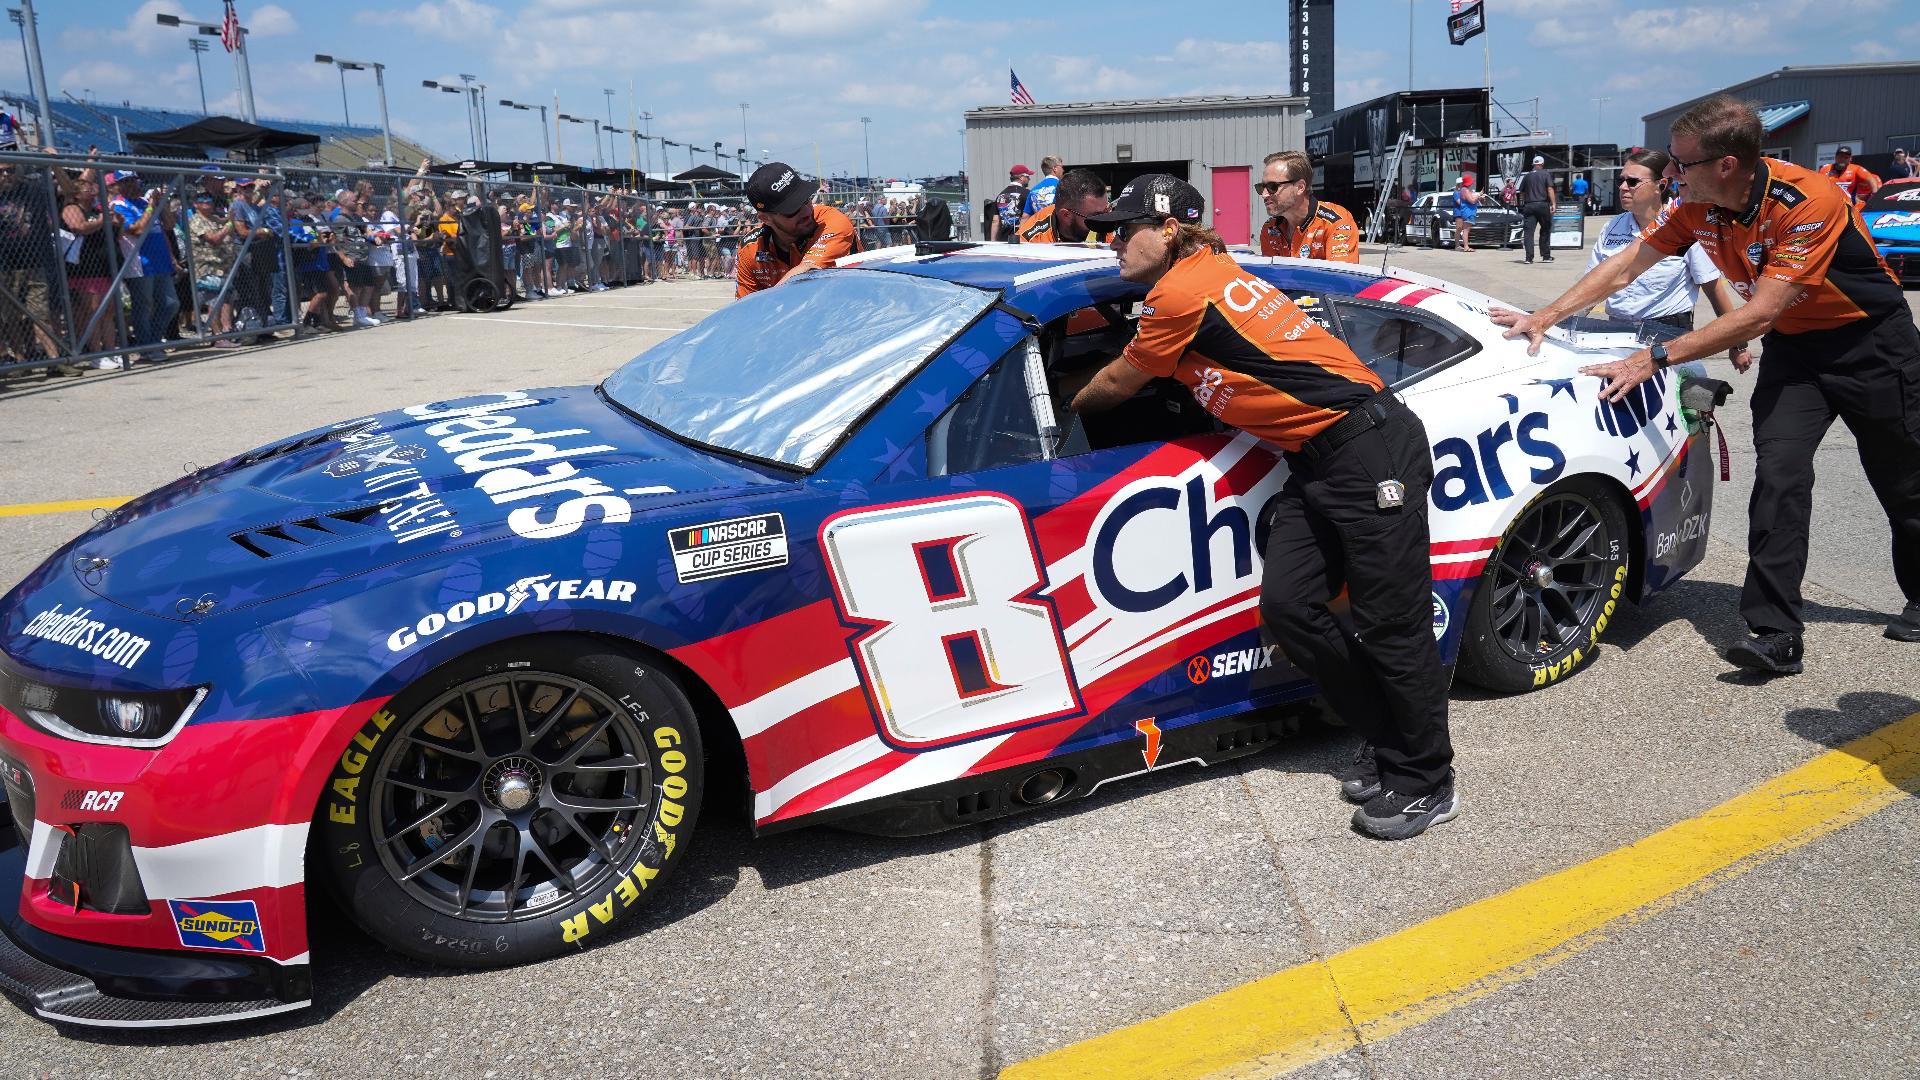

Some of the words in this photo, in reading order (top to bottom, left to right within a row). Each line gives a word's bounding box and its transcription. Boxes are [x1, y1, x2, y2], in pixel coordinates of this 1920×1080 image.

[1303, 0, 1309, 8] 2
[1303, 12, 1309, 22] 3
[1302, 26, 1309, 36] 4
[1303, 40, 1309, 50] 5
[1303, 54, 1309, 64] 6
[1303, 68, 1309, 78] 7
[1303, 82, 1309, 92] 8
[1284, 325, 1305, 342] Get
[708, 519, 767, 543] NASCAR
[1656, 523, 1682, 559] Bank
[1681, 512, 1707, 543] OZK
[692, 551, 721, 569] CUP
[723, 541, 772, 563] SERIES
[387, 577, 637, 652] GOODYEAR
[820, 492, 1087, 752] 8
[1533, 565, 1627, 687] GOODYEAR
[22, 603, 151, 669] cheddars.com
[1211, 644, 1277, 678] SENIX
[329, 706, 397, 825] EAGLE
[80, 790, 124, 812] RCR
[559, 726, 689, 944] GOODYEAR
[181, 917, 254, 934] SUNOCO
